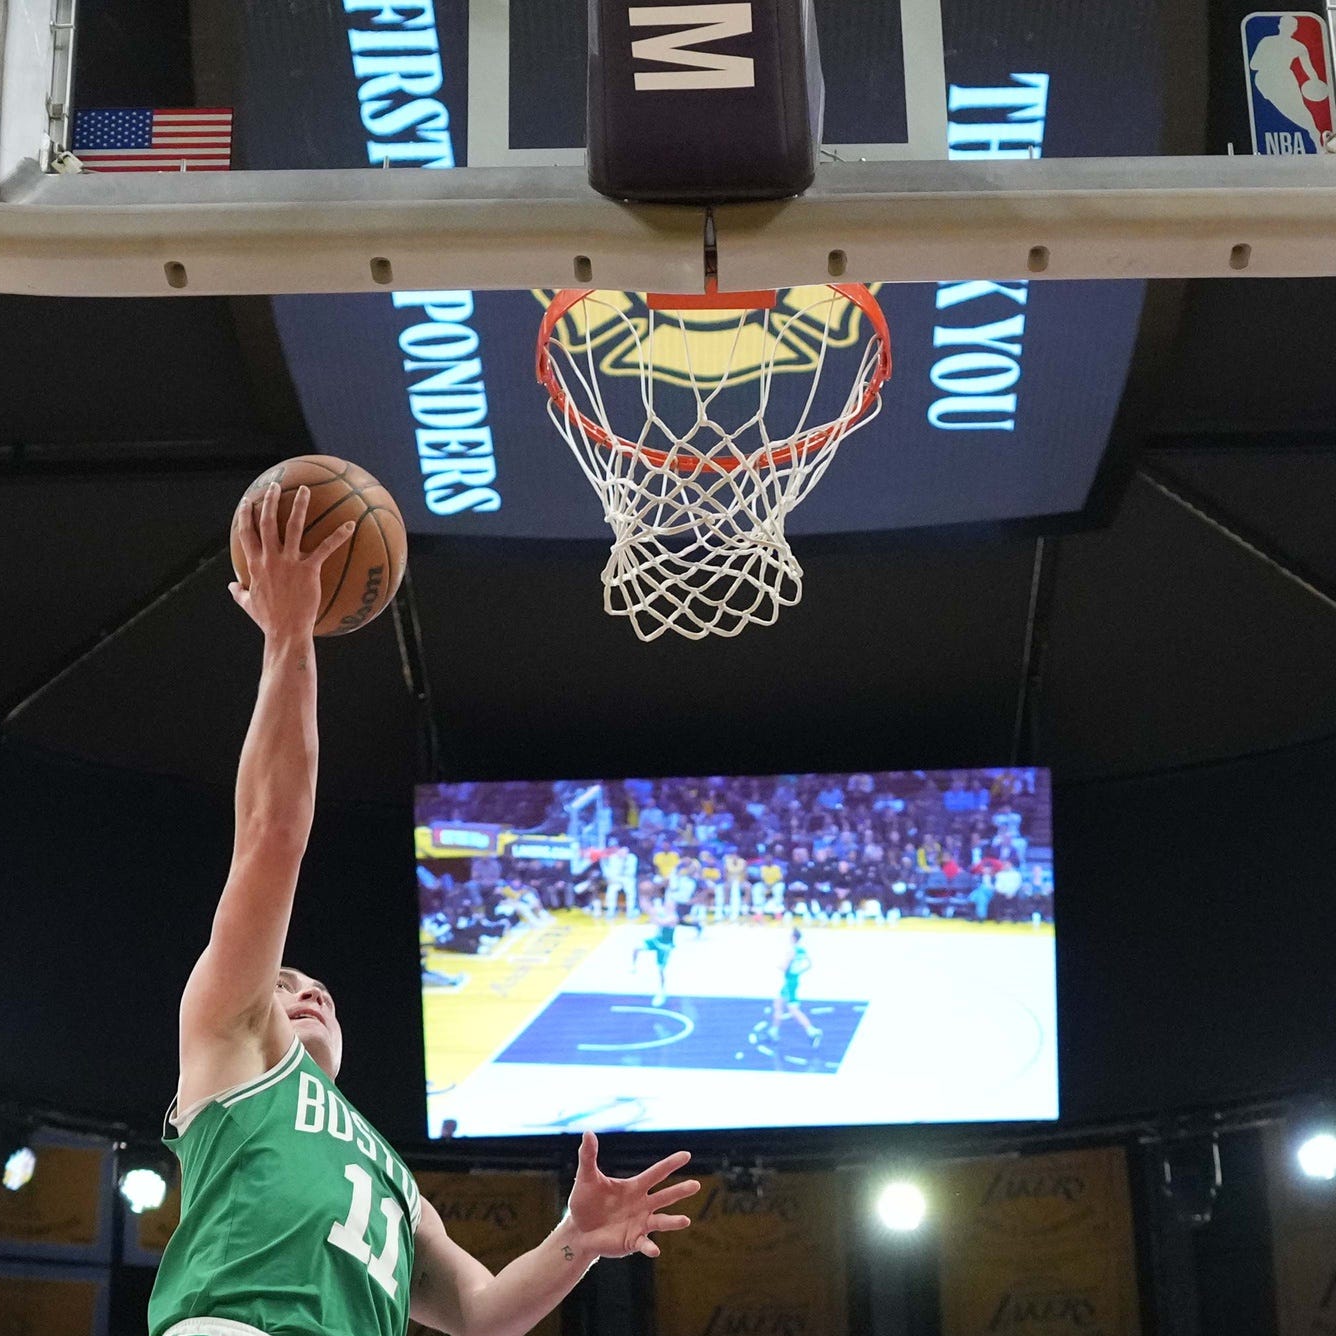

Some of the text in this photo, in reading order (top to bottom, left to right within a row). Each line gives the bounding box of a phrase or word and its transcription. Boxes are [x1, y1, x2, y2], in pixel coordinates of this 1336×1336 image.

[343, 0, 455, 169] FIRST
[1265, 131, 1306, 154] NBA
[391, 290, 501, 516] PONDERS
[927, 314, 1025, 431] YOU
[327, 1163, 403, 1300] 11
